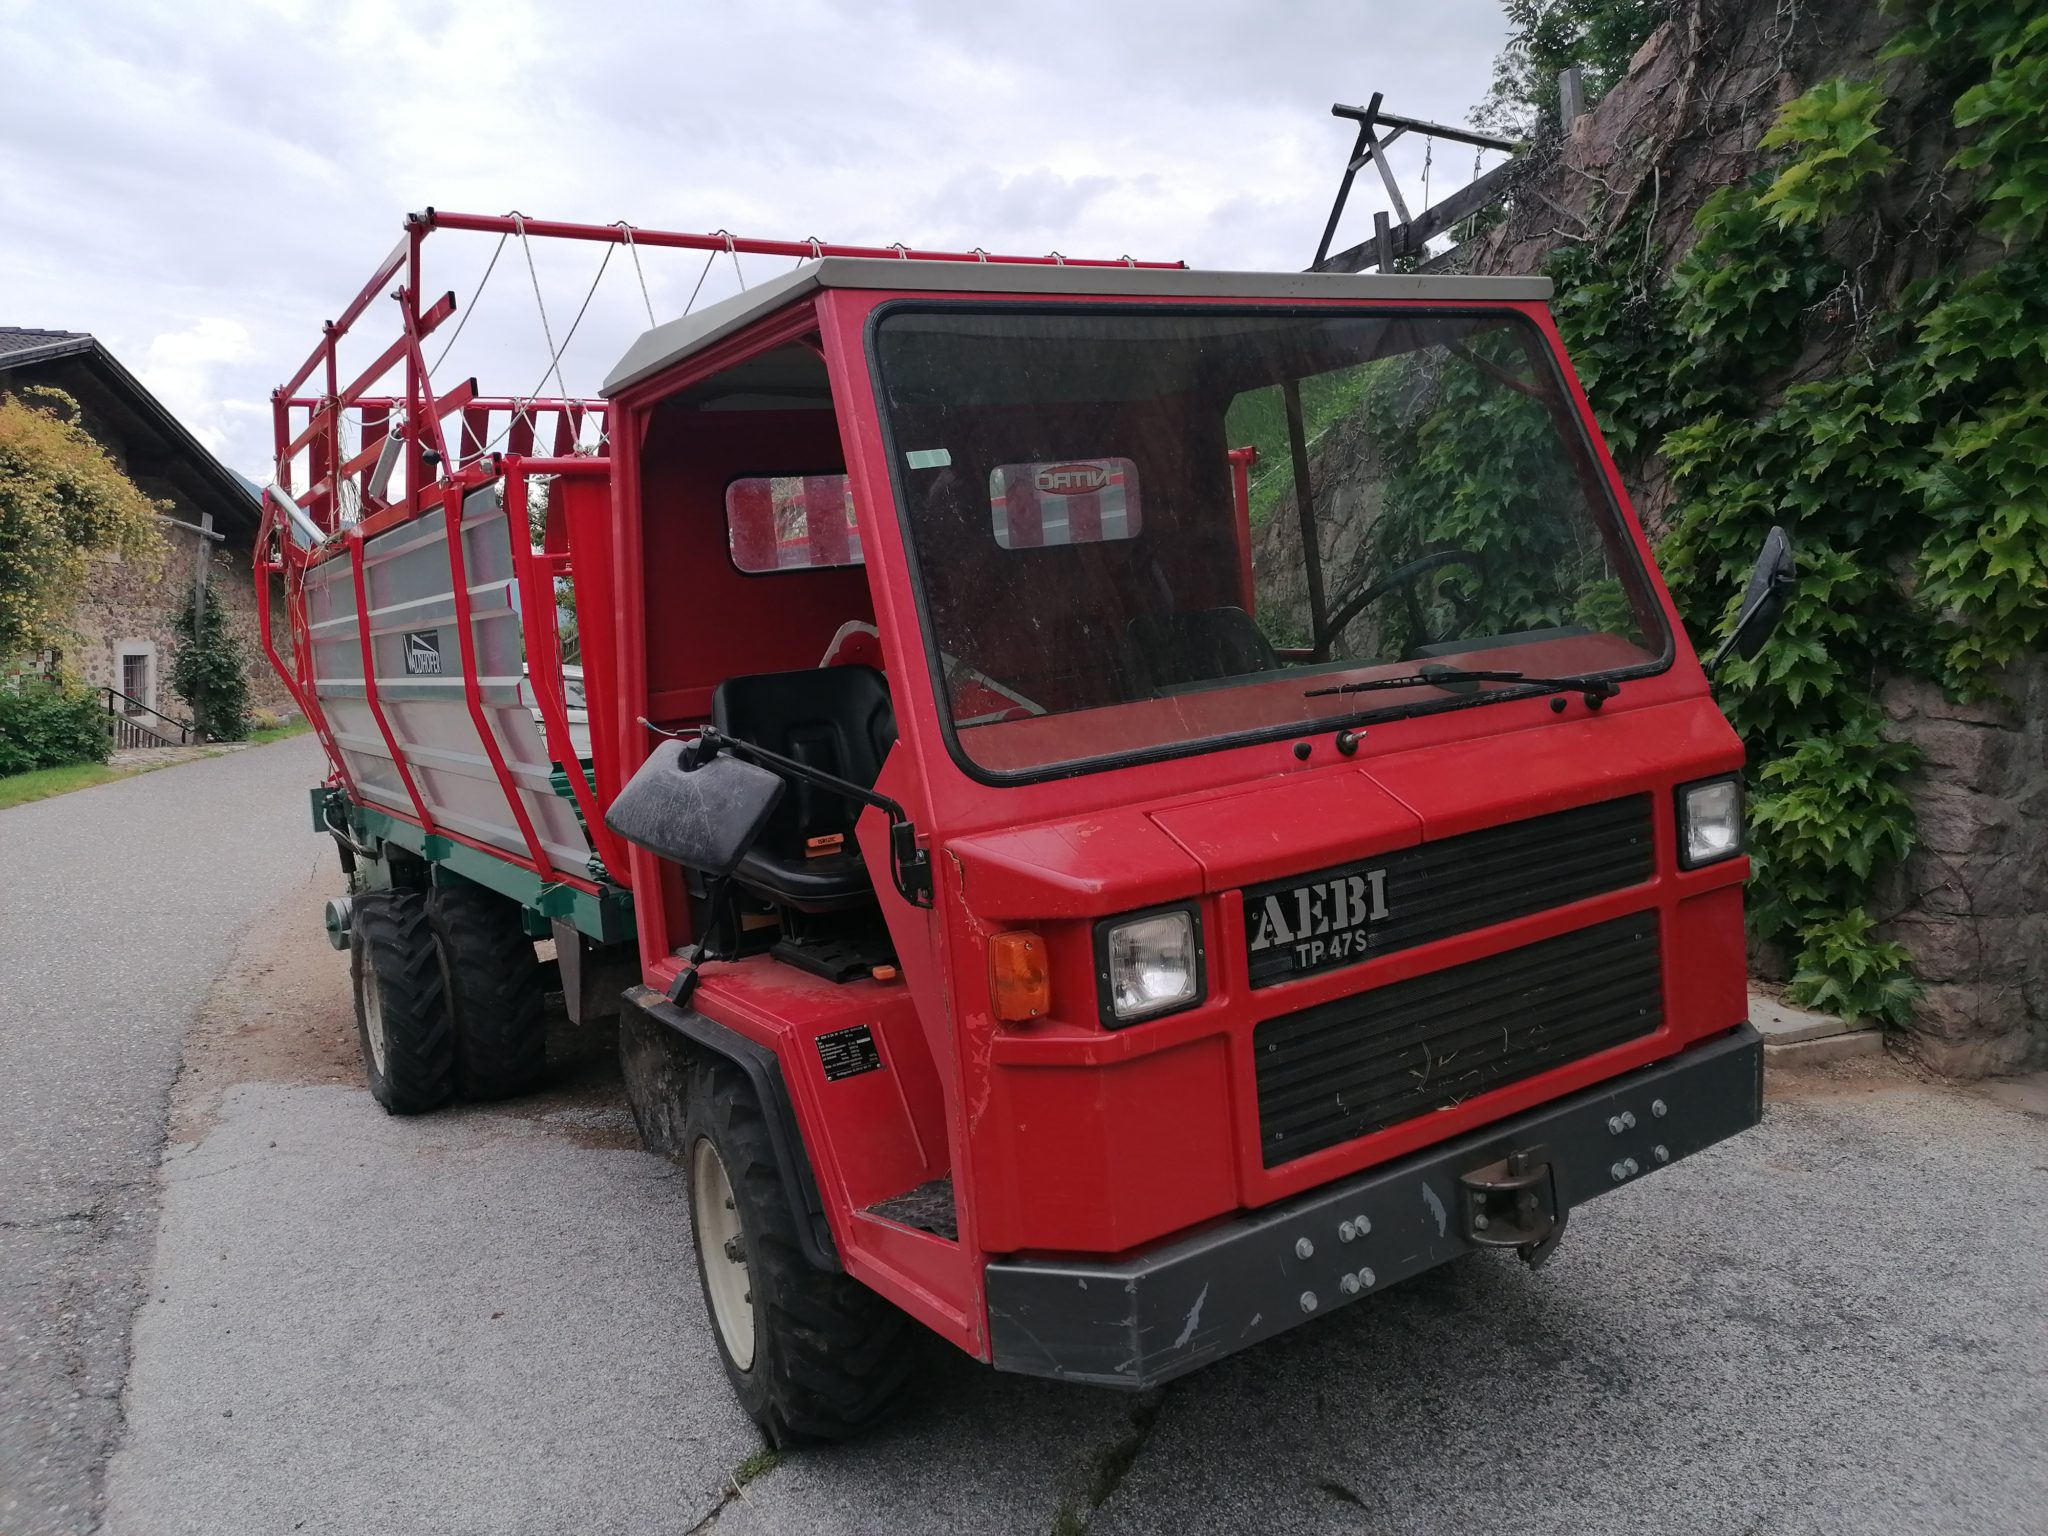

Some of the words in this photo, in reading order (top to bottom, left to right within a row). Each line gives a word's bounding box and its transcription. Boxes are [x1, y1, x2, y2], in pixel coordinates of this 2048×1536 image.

[402, 634, 442, 674] WALDHOFER
[1251, 868, 1389, 951] AEBI
[1296, 940, 1325, 968] TP
